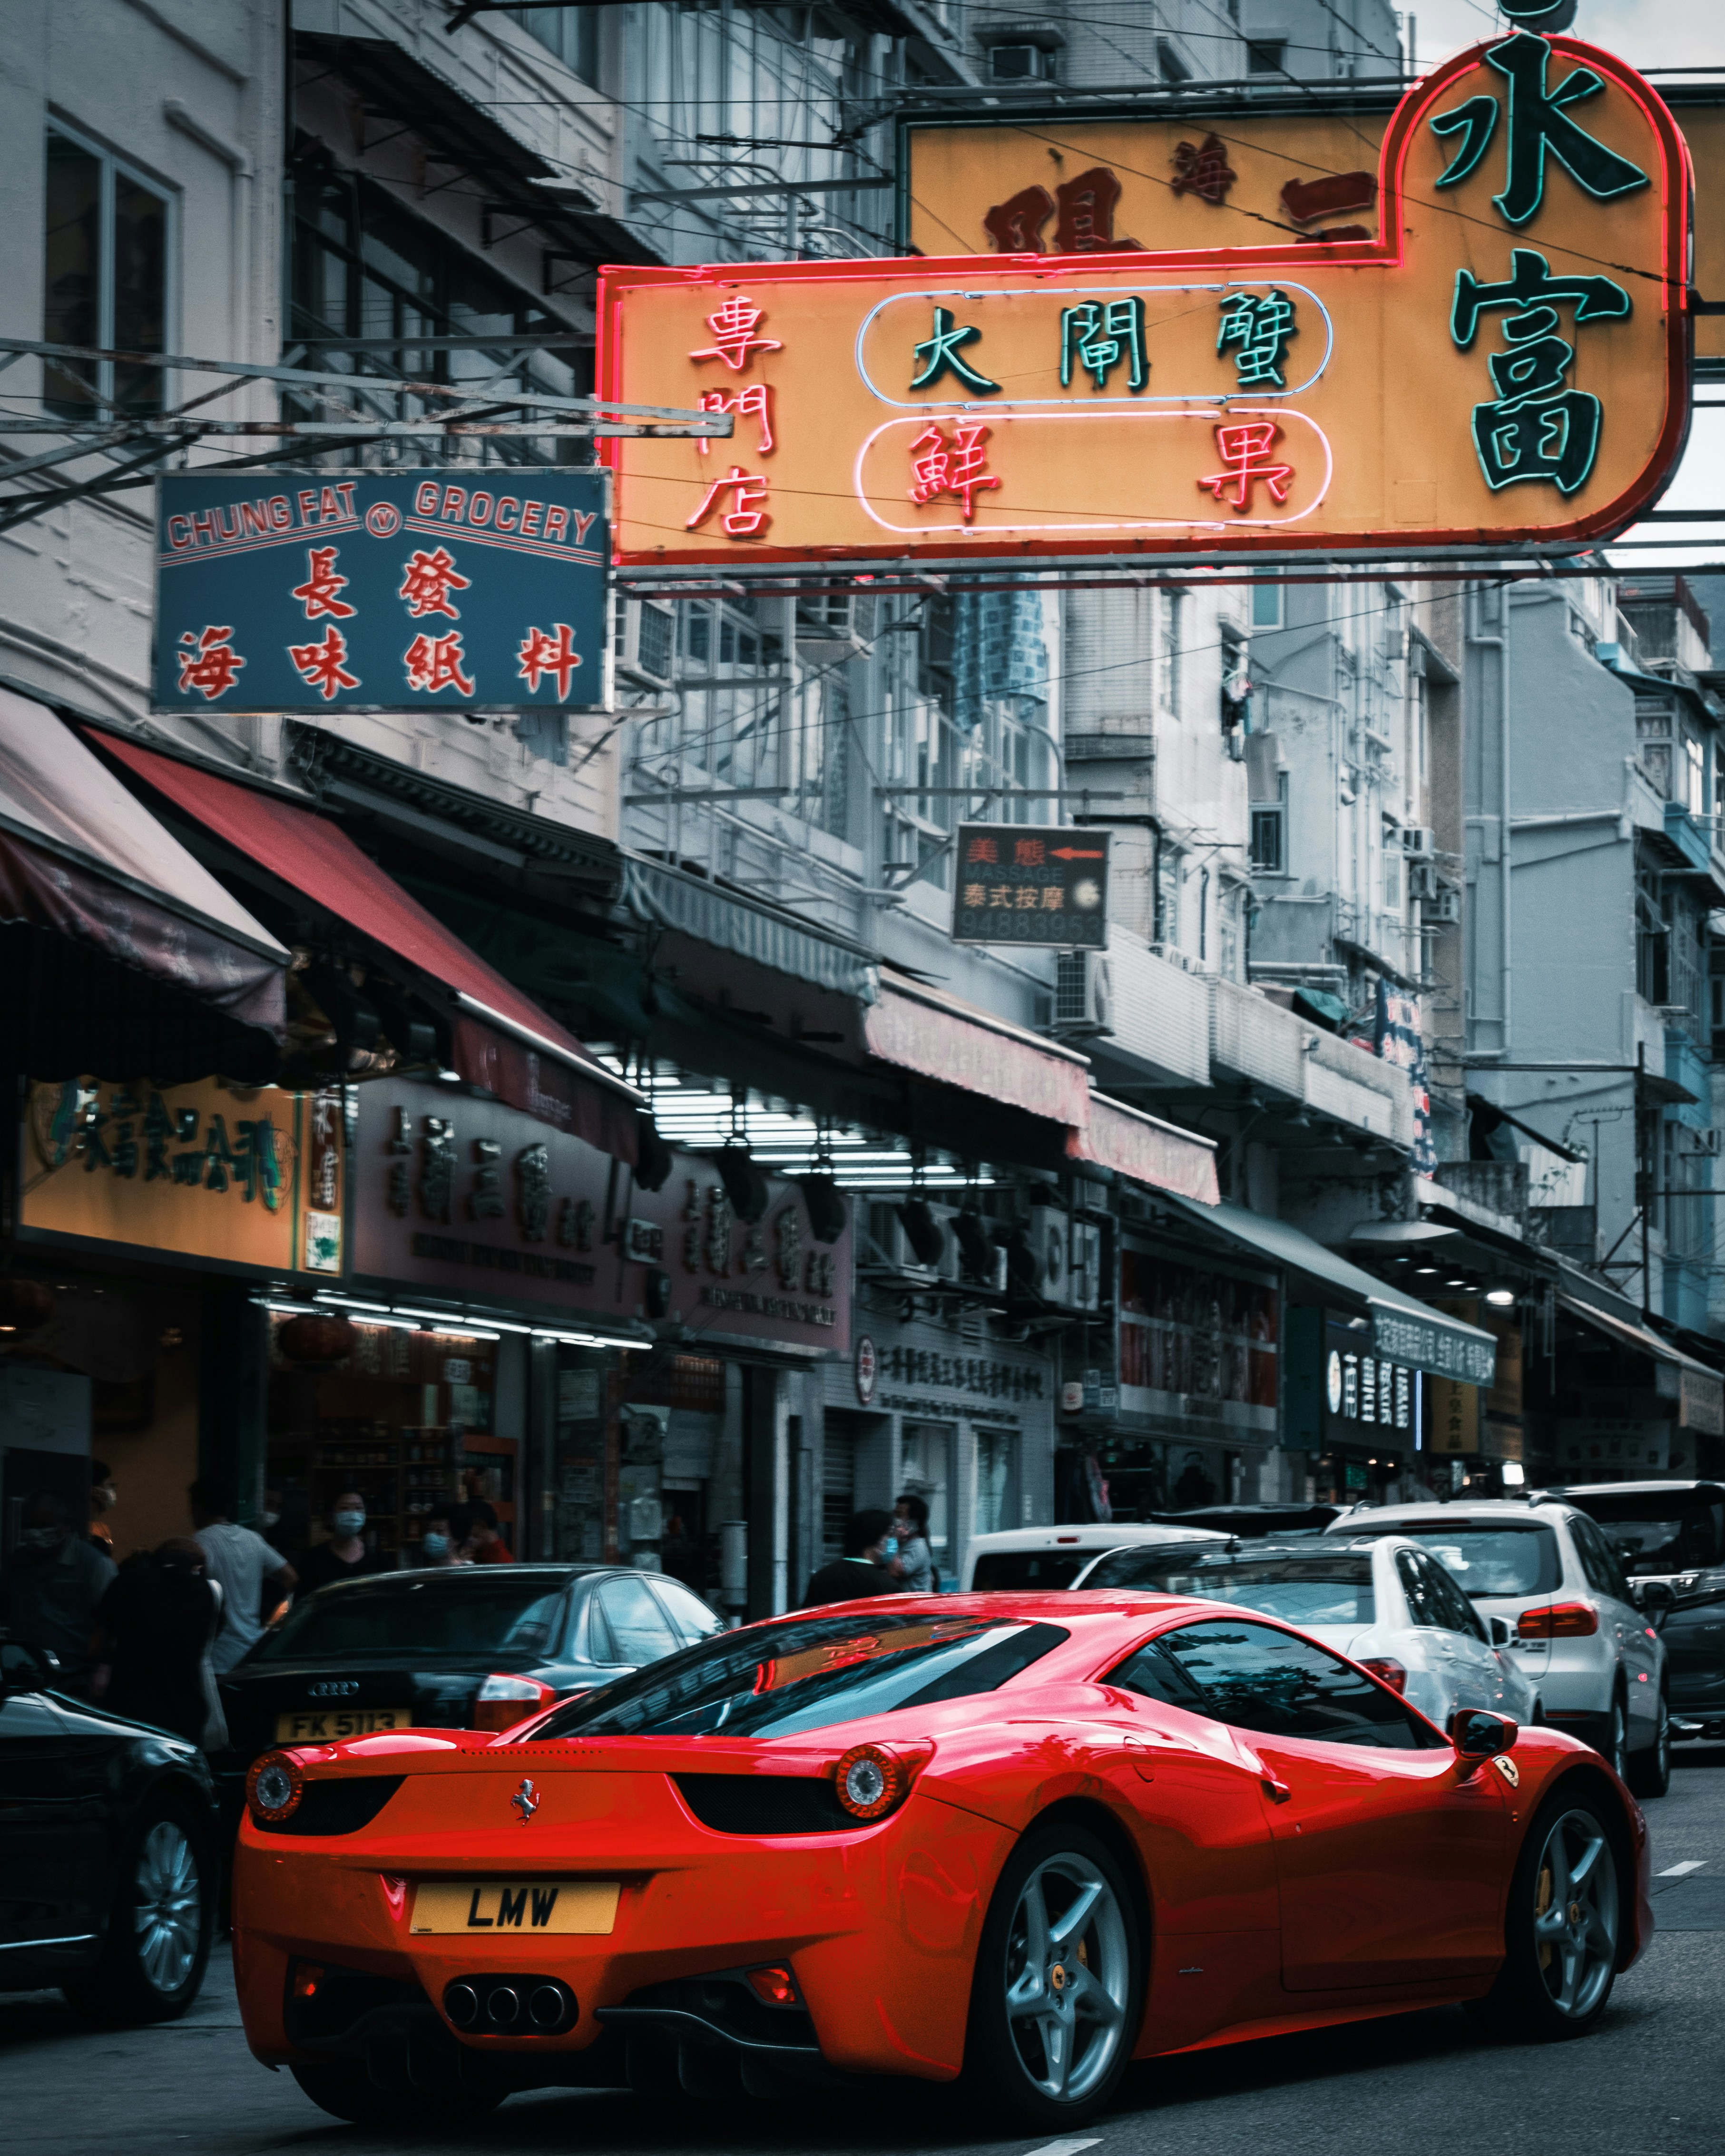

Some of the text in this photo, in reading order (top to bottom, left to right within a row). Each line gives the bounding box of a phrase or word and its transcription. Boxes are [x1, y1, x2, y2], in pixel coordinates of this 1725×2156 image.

[910, 290, 1296, 395] 大閘蟹
[686, 294, 780, 538] 專門店
[908, 421, 1293, 521] 鮮果
[167, 495, 292, 550] CHUNG
[297, 480, 358, 526] FAT
[414, 480, 598, 545] GROCERY
[292, 545, 471, 620] 長發
[176, 624, 583, 703] 海味紙料
[963, 883, 1065, 911] 泰式按摩
[964, 864, 1064, 883] MASSAGE
[468, 1888, 559, 1927] LMW
